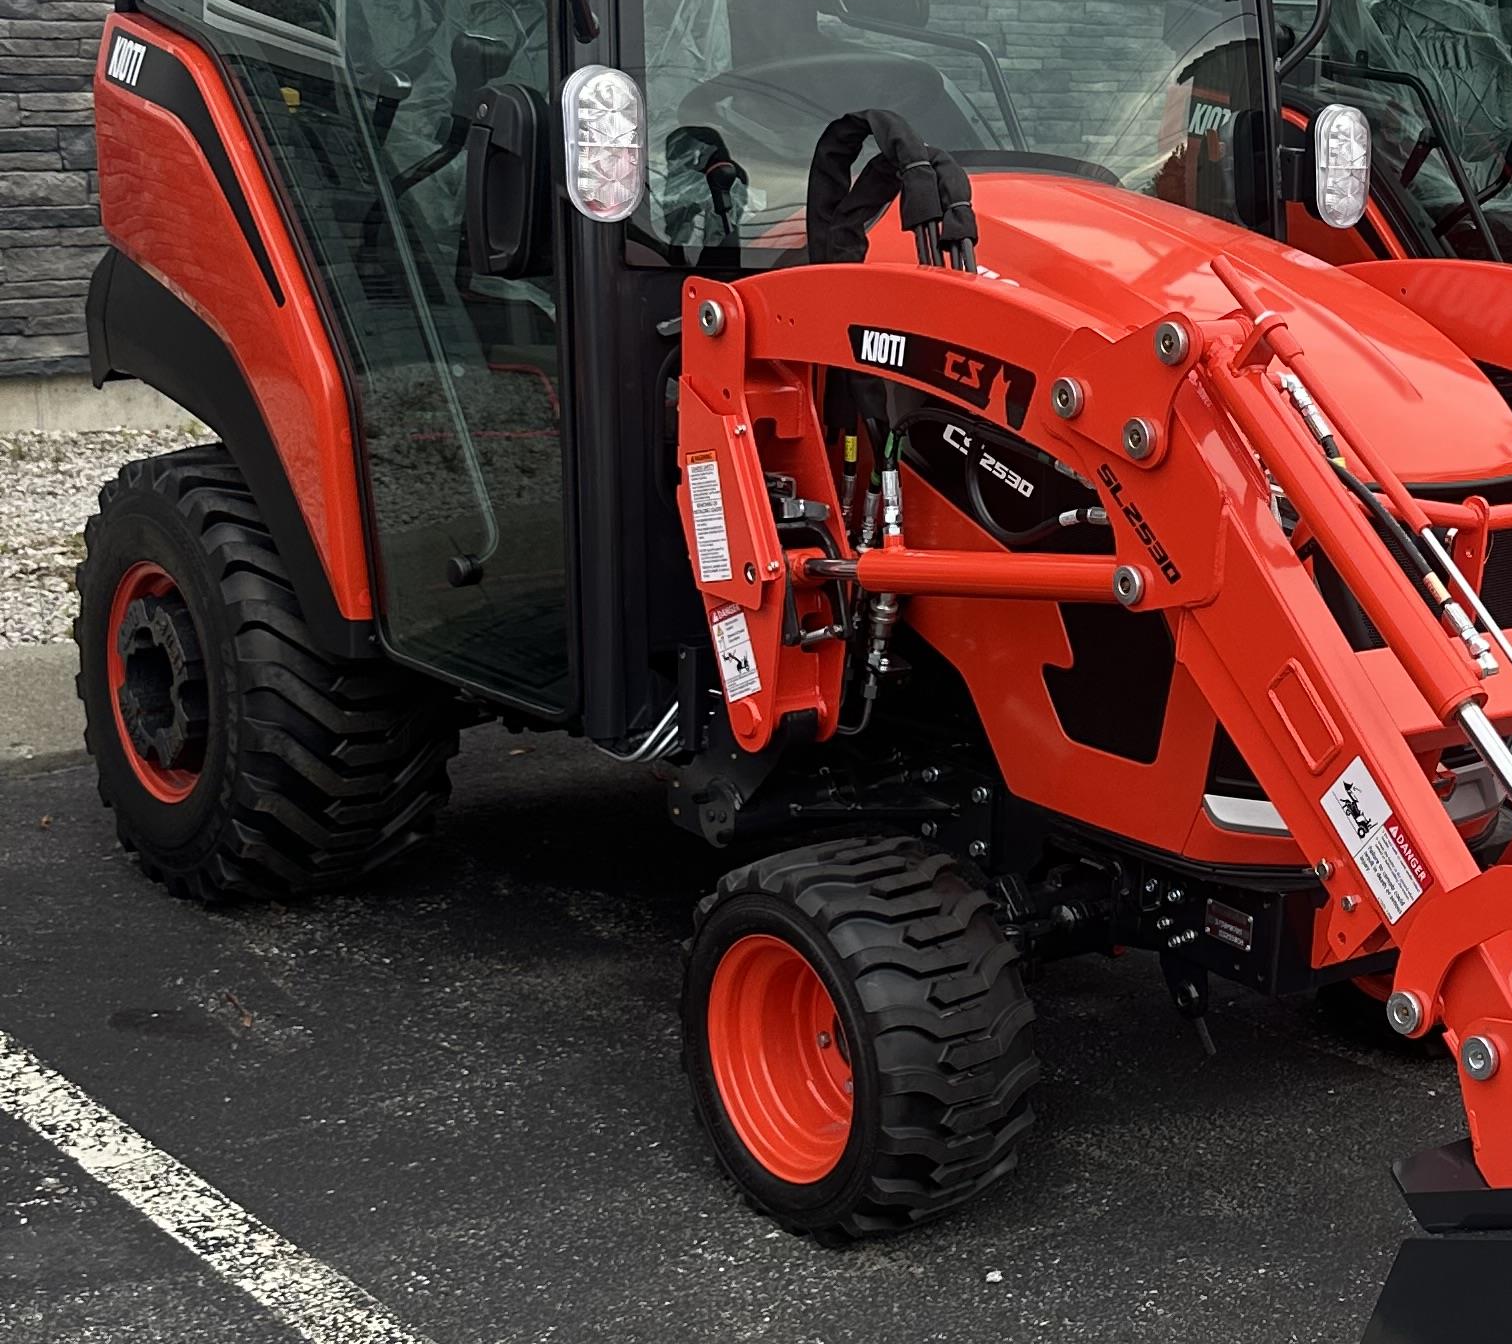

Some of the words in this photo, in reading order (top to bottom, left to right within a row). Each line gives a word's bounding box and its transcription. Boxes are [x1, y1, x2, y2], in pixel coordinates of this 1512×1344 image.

[108, 35, 147, 87] KIOTI
[861, 329, 907, 367] KIOTI
[979, 452, 1035, 498] 2530
[1096, 463, 1182, 585] SL2530
[1396, 833, 1427, 881] DANGER
